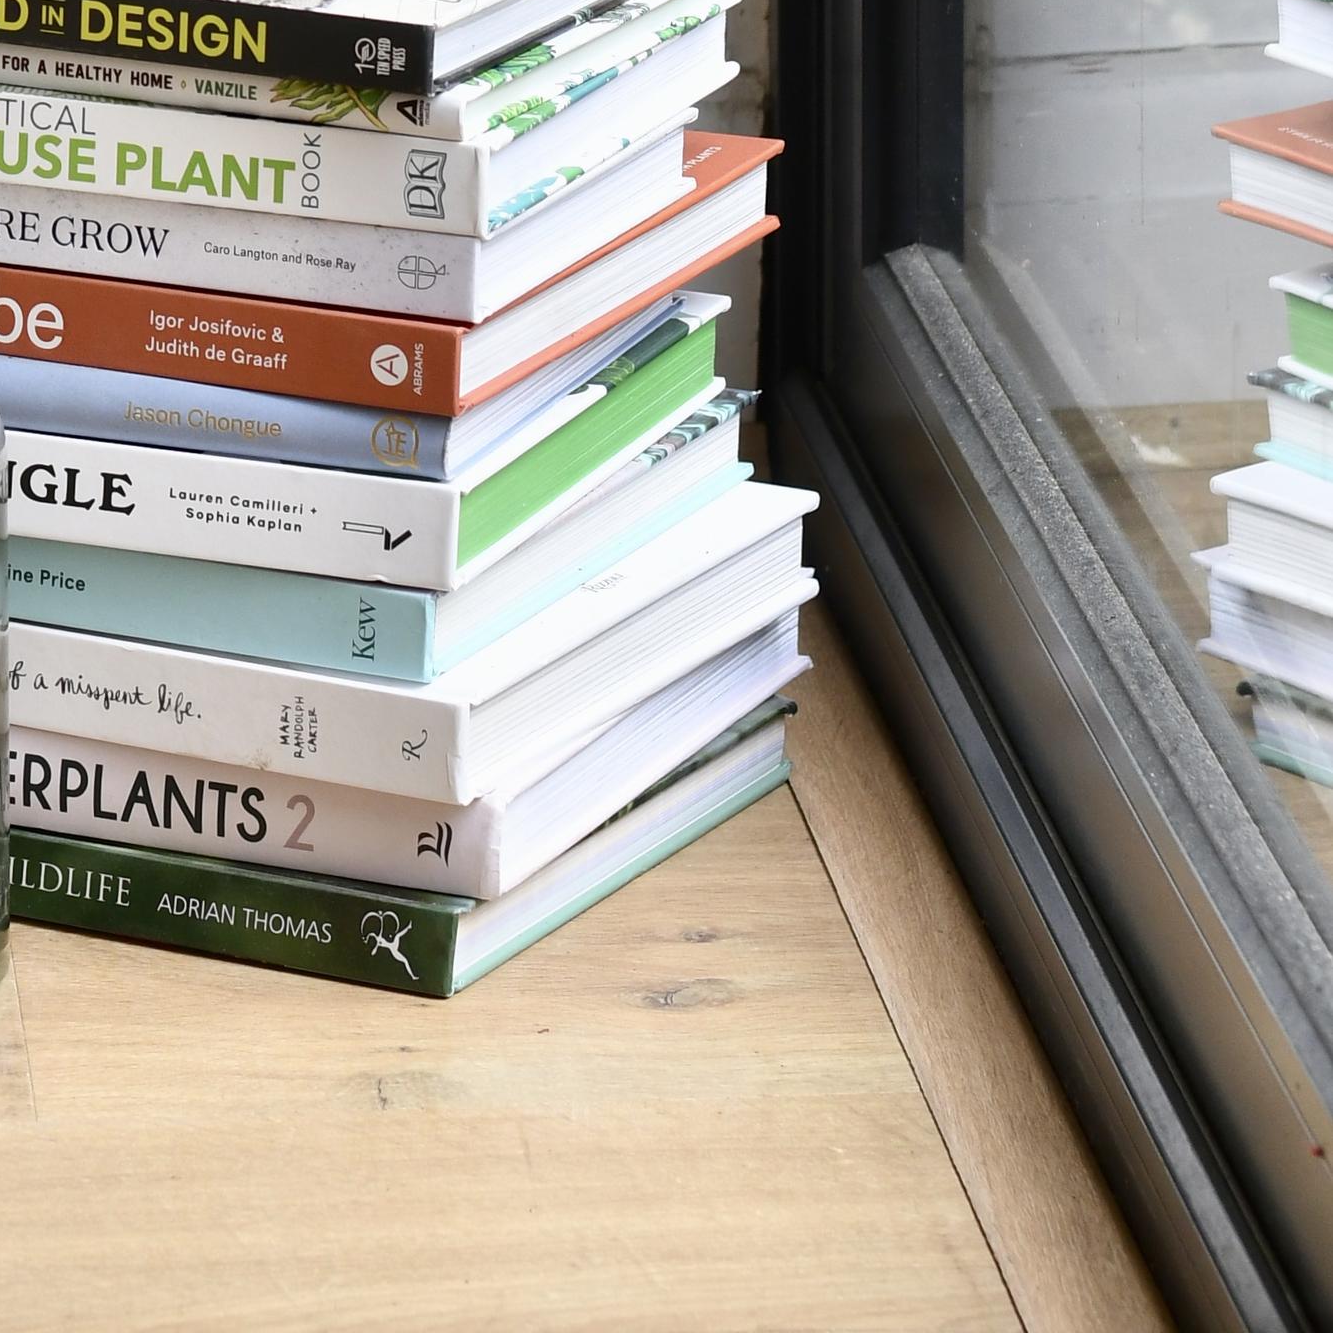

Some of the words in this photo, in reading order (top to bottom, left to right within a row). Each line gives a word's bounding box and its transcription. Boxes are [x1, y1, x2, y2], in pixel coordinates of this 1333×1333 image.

[40, 2, 66, 29] IN
[376, 62, 392, 76] TEN
[377, 36, 392, 62] SPEED
[391, 46, 407, 72] PRESS
[2, 48, 30, 72] FOR
[36, 54, 48, 75] A
[54, 60, 123, 85] HEALTHY
[129, 68, 174, 91] HOME
[194, 77, 259, 103] VANZILE
[116, 142, 296, 202] PLANT
[301, 133, 322, 209] BOOK
[407, 155, 440, 213] DK
[52, 215, 170, 260] GROW
[203, 241, 231, 257] Caro
[233, 245, 279, 262] Langton
[281, 251, 303, 265] and
[305, 253, 333, 270] Rose
[335, 256, 357, 273] Ray
[149, 309, 185, 332] Igor
[189, 315, 267, 341] Josifovic
[271, 326, 285, 344] &
[145, 336, 201, 359] Judith
[204, 343, 227, 362] de
[231, 348, 288, 371] Graaff
[412, 342, 425, 397] ABRAMS
[124, 401, 182, 428] Jason
[187, 408, 283, 439] Chongue
[169, 487, 223, 505] Lauren
[230, 495, 304, 516] Camilleri
[185, 507, 241, 527] Sophia
[246, 515, 303, 533] Kaplan
[39, 570, 87, 593] Price
[351, 596, 377, 662] Kew
[33, 673, 49, 690] a
[55, 675, 153, 710] misspent
[157, 683, 203, 724] life.
[279, 704, 292, 746] MARY
[293, 695, 306, 759] RANDOLPH
[307, 706, 318, 754] CARTER
[282, 793, 316, 853] 2
[156, 892, 237, 927] ADRIAN
[242, 906, 334, 945] THOMAS
